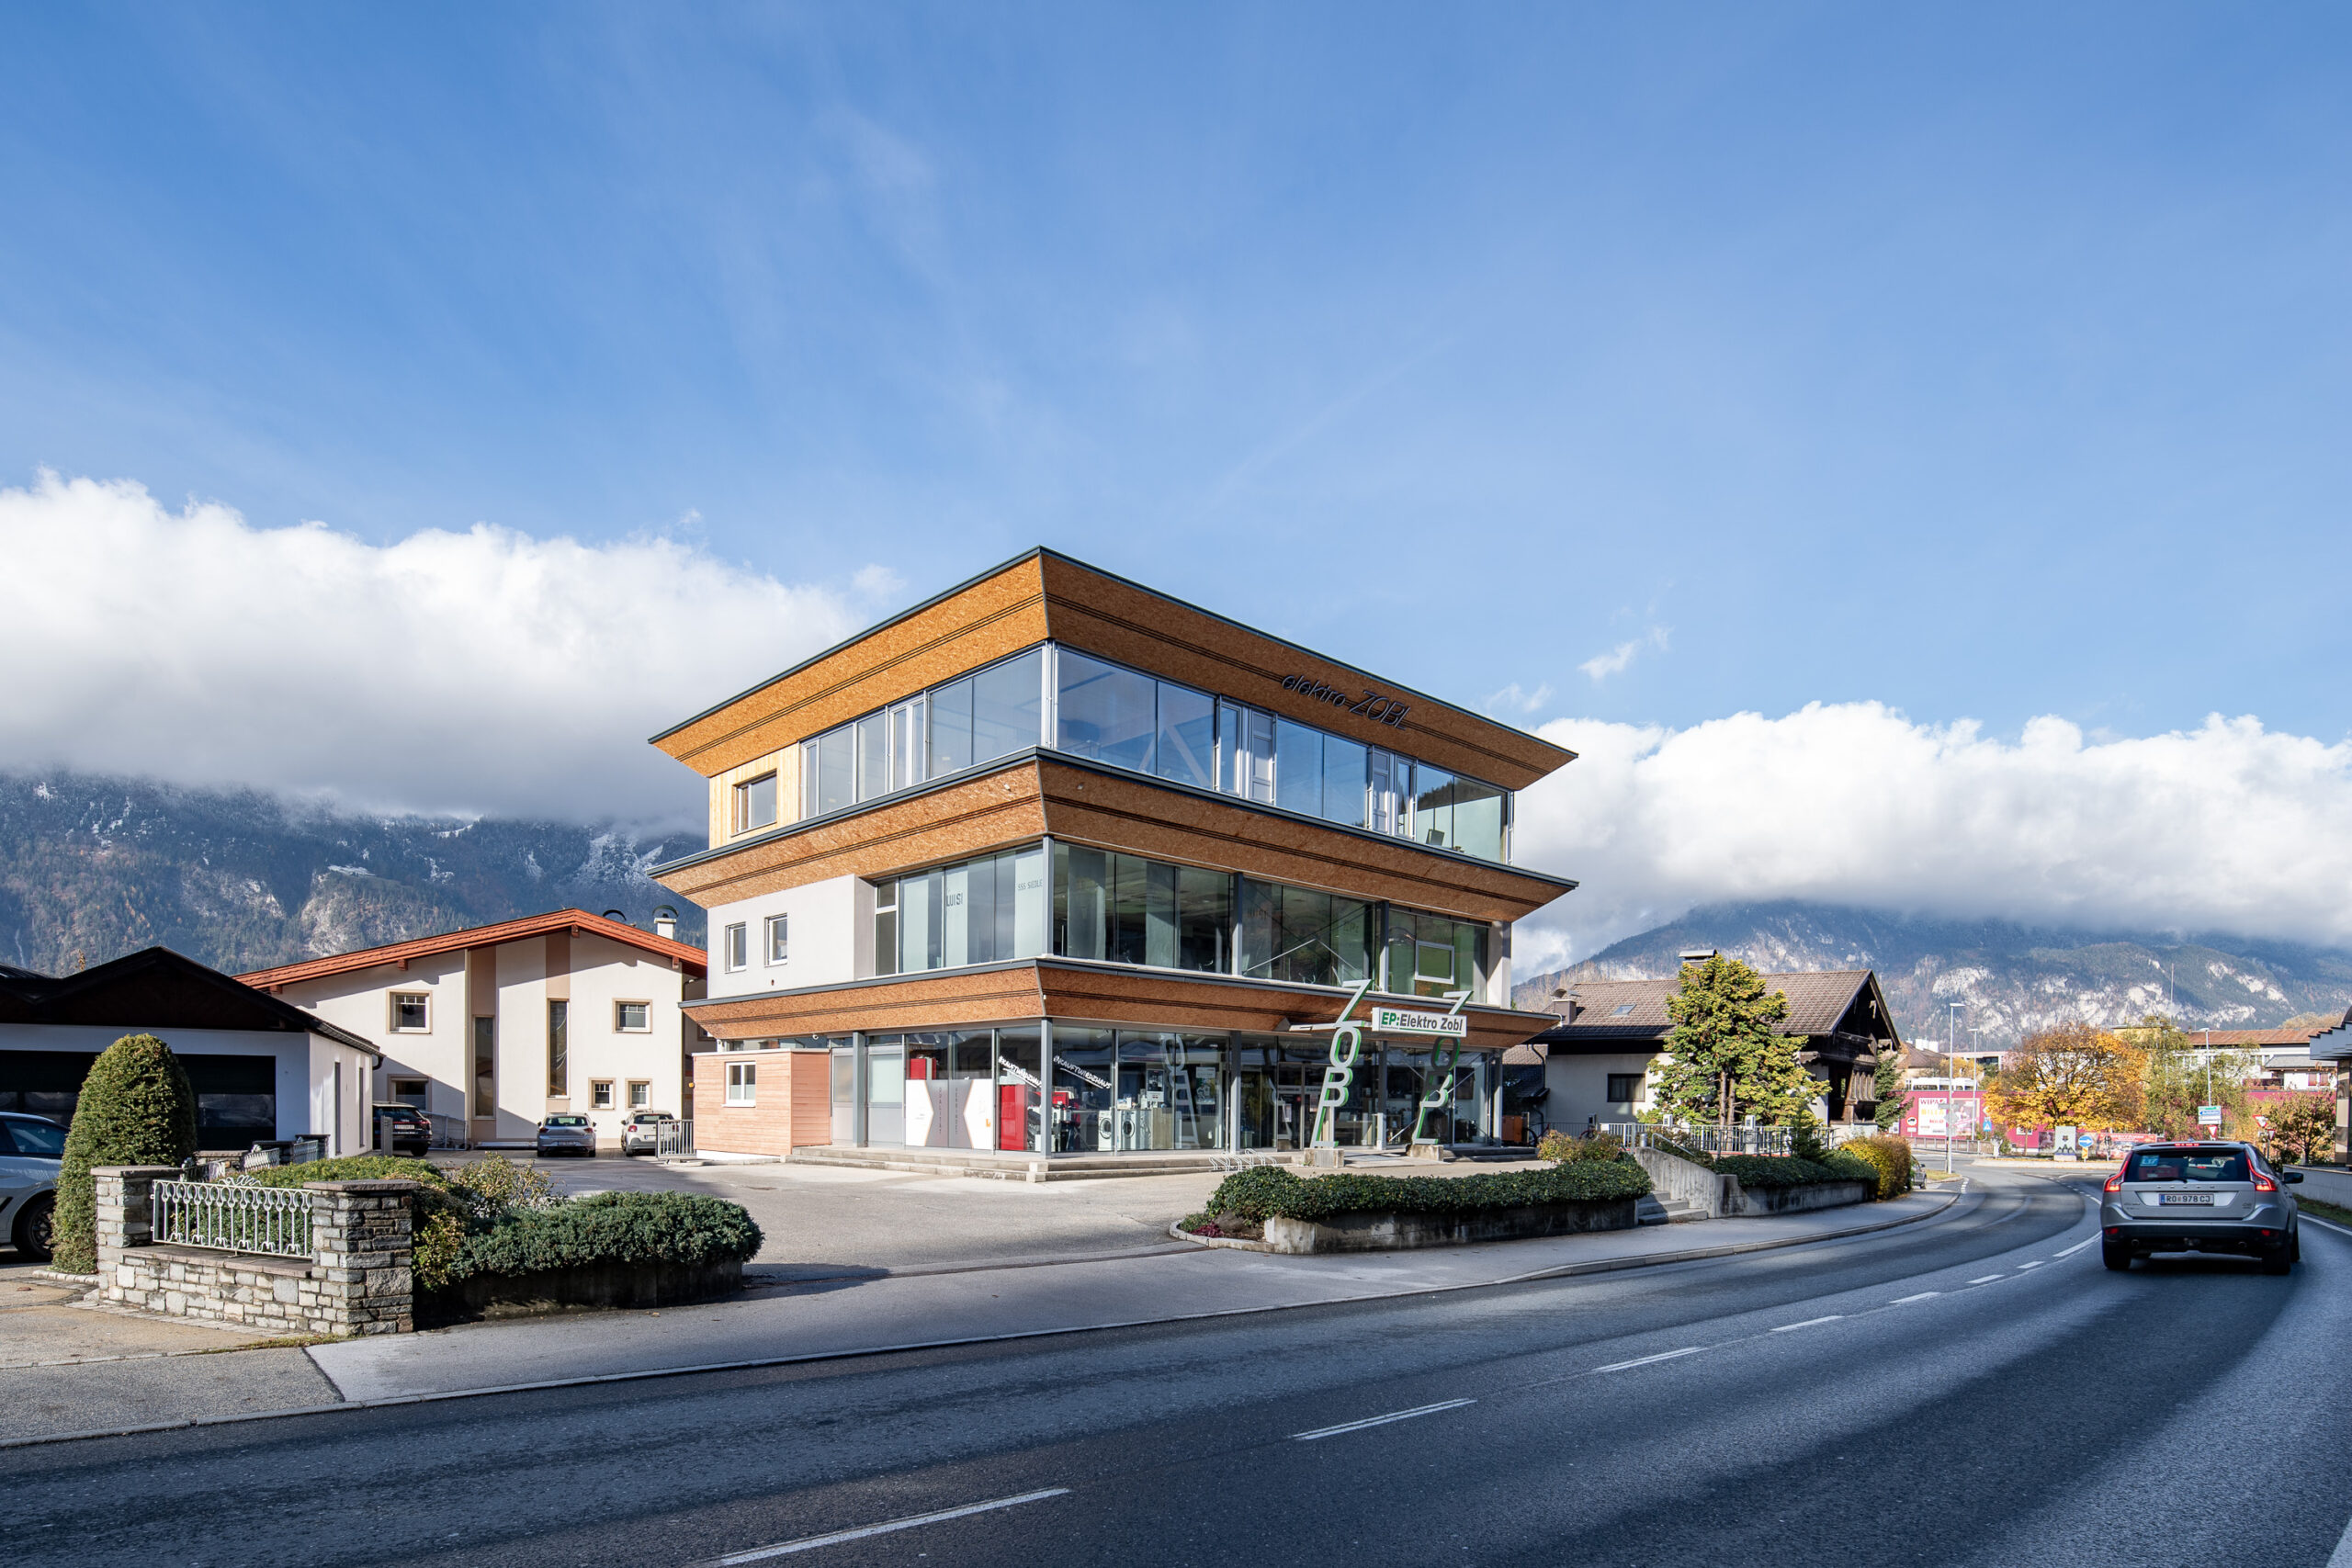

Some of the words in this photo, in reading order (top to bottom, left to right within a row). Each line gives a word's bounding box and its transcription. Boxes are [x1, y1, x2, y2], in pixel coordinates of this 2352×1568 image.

[1282, 675, 1346, 707] elektro
[1349, 690, 1411, 731] ZOBL
[1440, 1017, 1464, 1032] Zobl
[1309, 979, 1374, 1149] ZOBL
